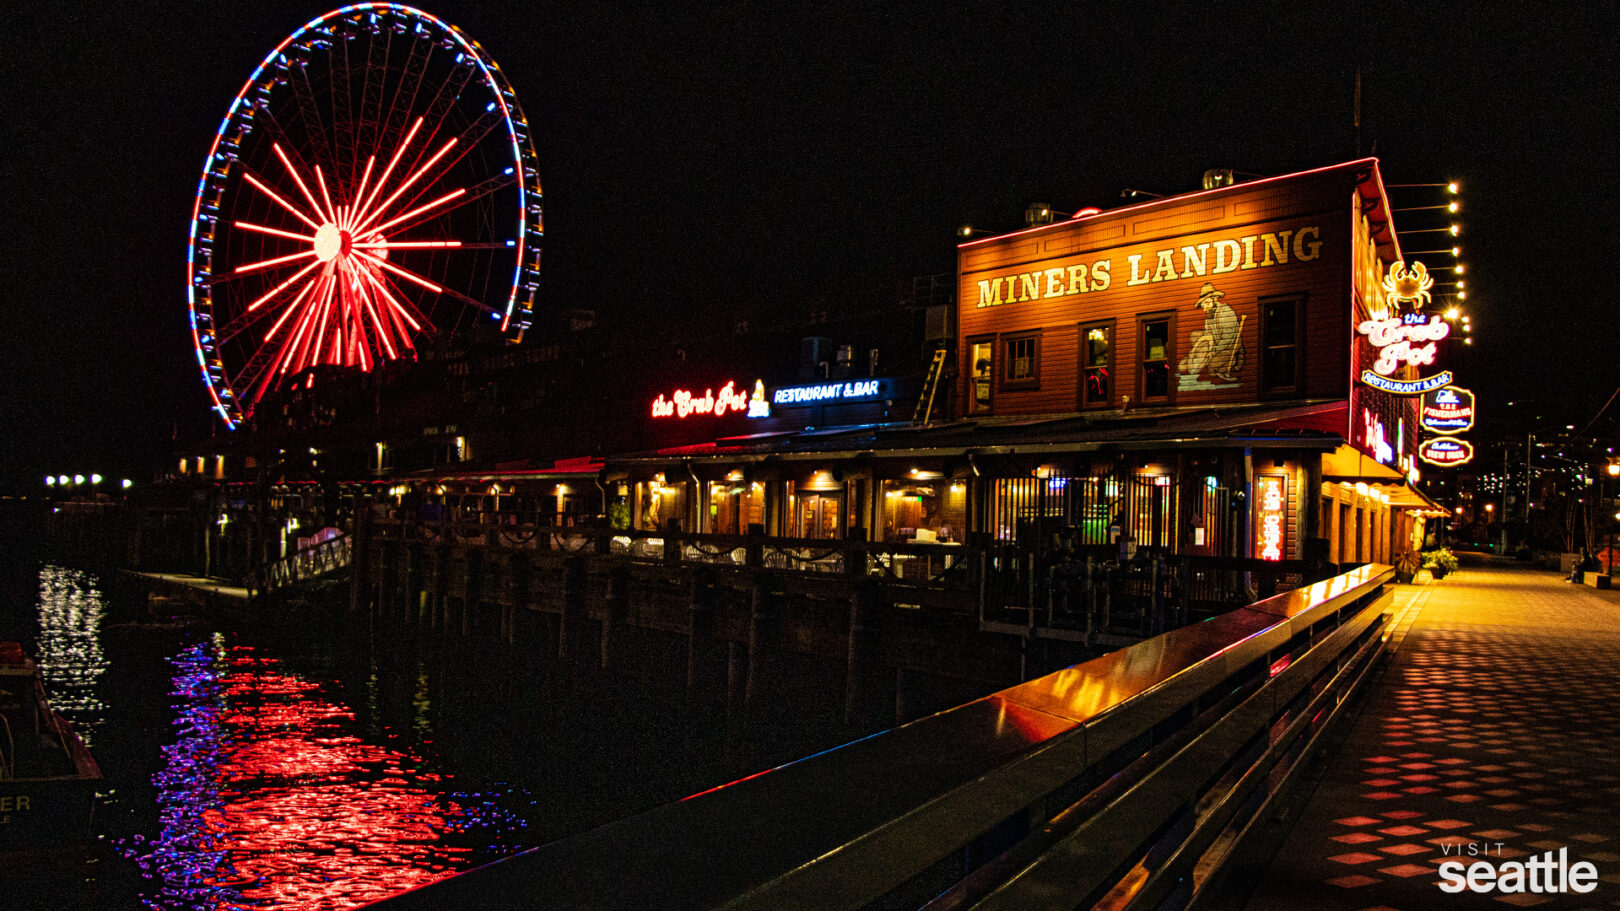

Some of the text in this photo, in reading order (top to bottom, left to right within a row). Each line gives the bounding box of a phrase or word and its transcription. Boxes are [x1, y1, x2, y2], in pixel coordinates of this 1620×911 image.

[977, 226, 1323, 308] MINERS LANDING
[1358, 315, 1449, 347] Crab
[1404, 314, 1425, 325] the
[774, 384, 843, 404] RESTAURANT
[854, 380, 879, 396] BAR
[1363, 373, 1423, 393] RESTAURANT
[652, 381, 747, 418] the Crab Pot
